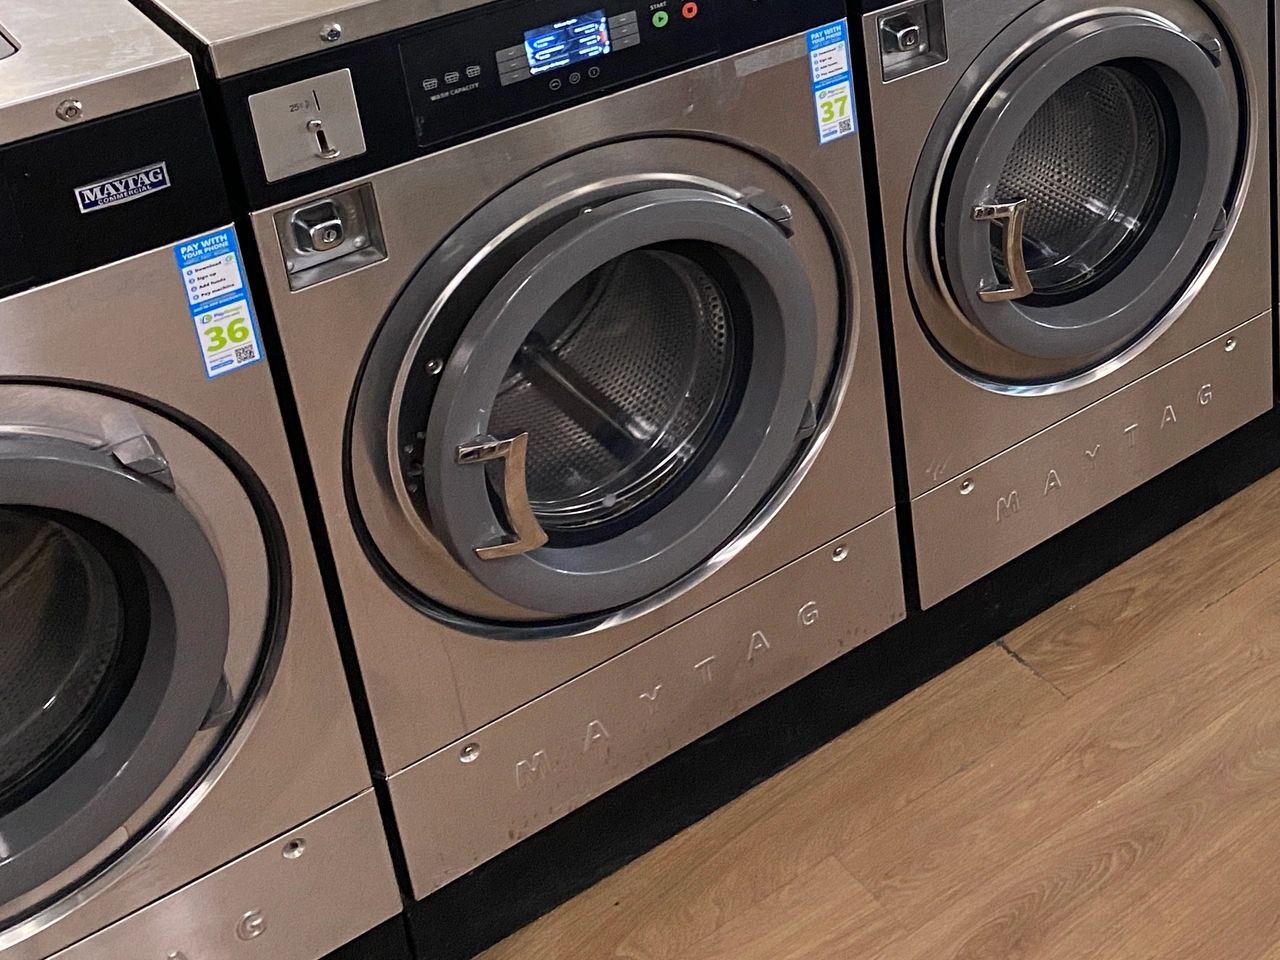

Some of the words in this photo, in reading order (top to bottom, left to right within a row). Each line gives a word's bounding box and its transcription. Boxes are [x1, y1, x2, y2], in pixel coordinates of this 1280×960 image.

[650, 1, 667, 11] START
[811, 30, 823, 40] PAY
[820, 95, 848, 123] 37
[82, 168, 163, 204] MAYTAG
[98, 184, 152, 206] COMMERCIAL
[181, 242, 200, 255] PAY
[201, 233, 228, 248] WITH
[182, 249, 204, 261] YOUR
[204, 240, 229, 253] PHONE
[204, 317, 250, 353] 36
[995, 382, 1214, 524] MAYTAG
[514, 599, 820, 792] MAYTAG
